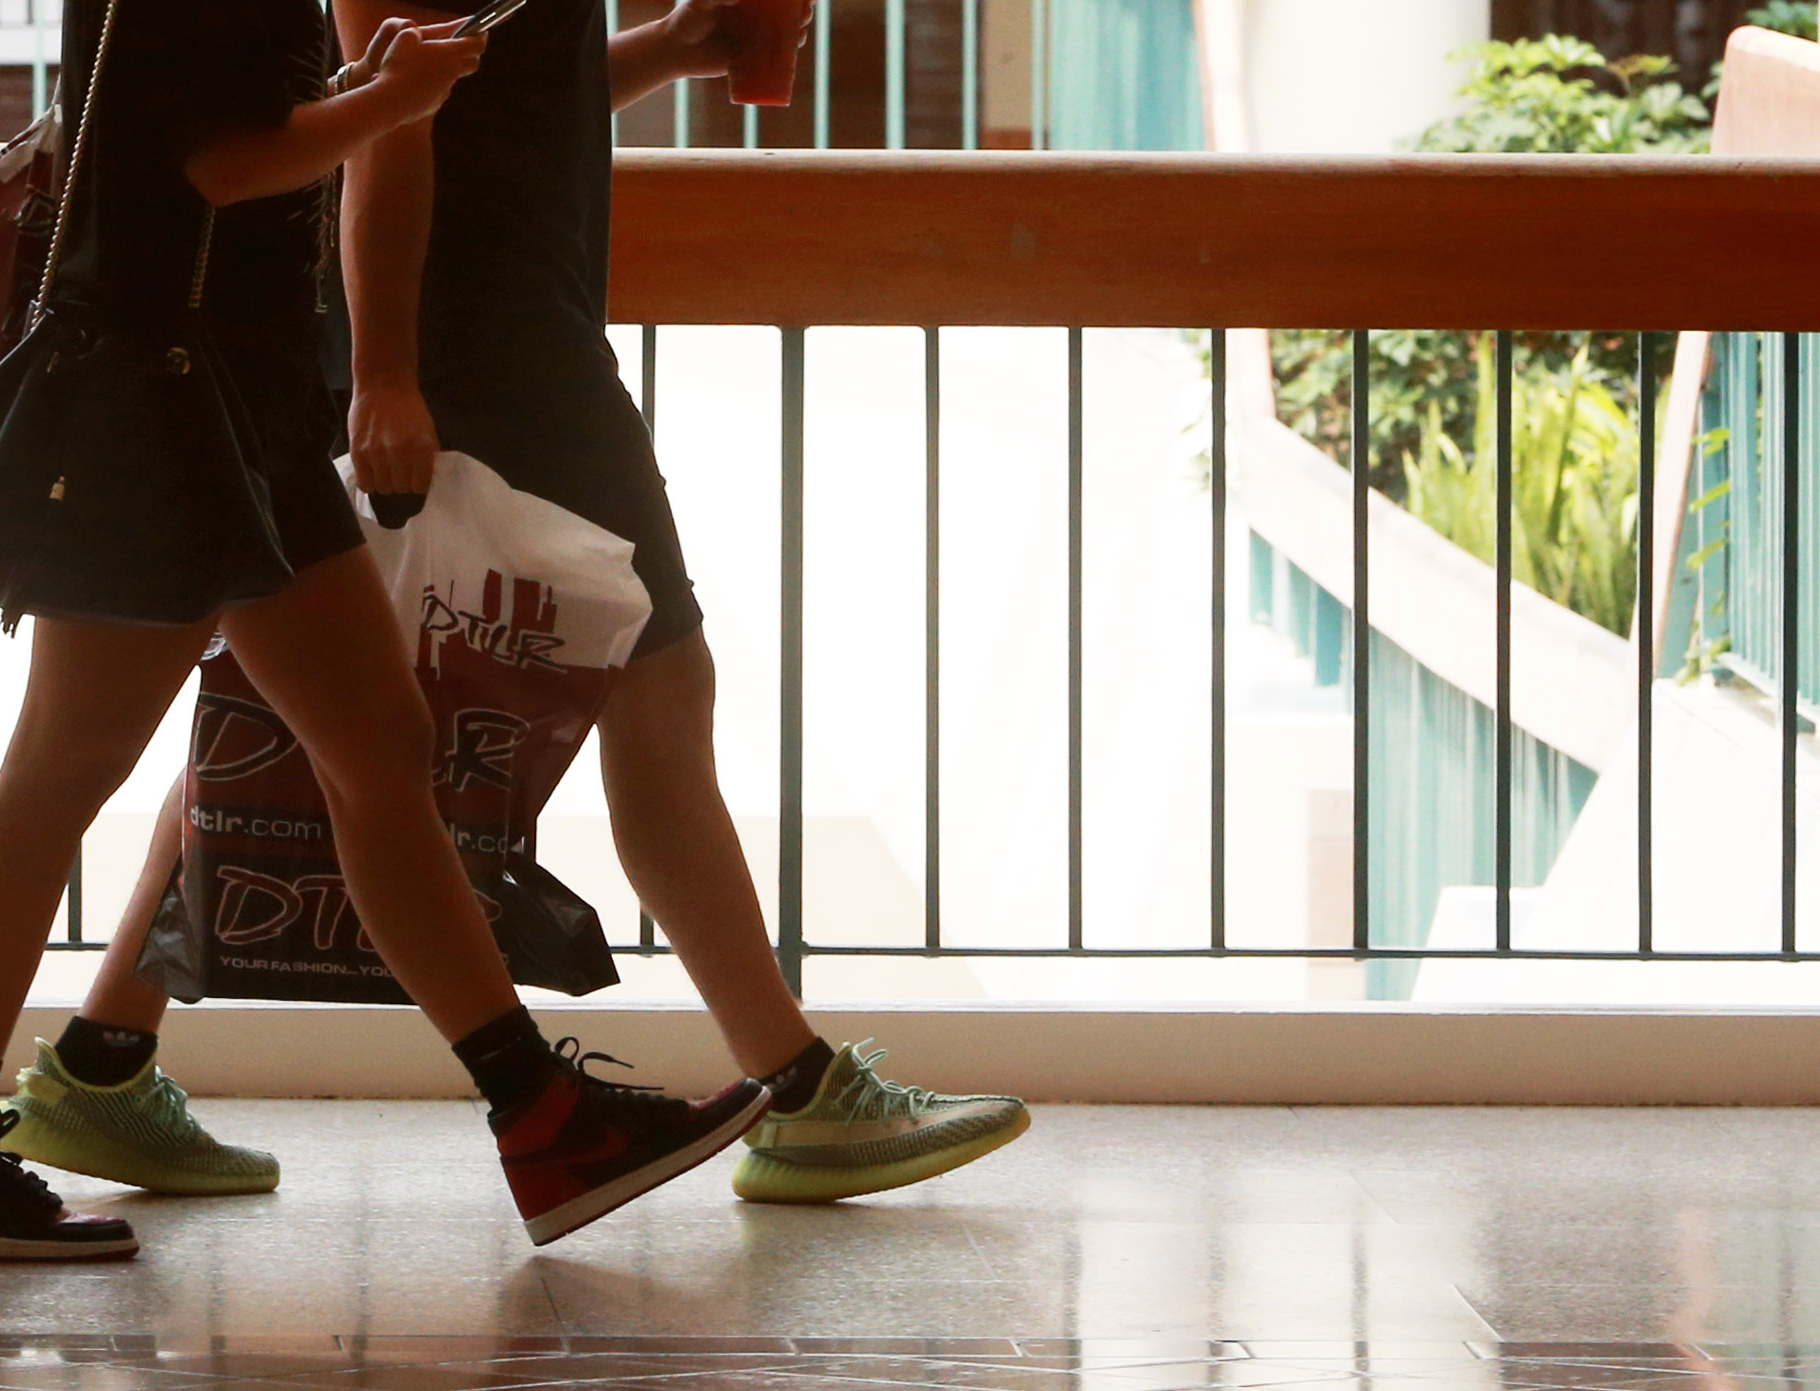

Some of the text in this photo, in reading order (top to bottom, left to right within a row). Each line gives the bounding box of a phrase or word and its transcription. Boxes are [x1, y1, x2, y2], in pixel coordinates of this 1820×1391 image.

[423, 593, 569, 675] DTLR
[192, 691, 530, 793] DR
[189, 805, 322, 841] dtlr.com
[220, 955, 269, 970] YOUR
